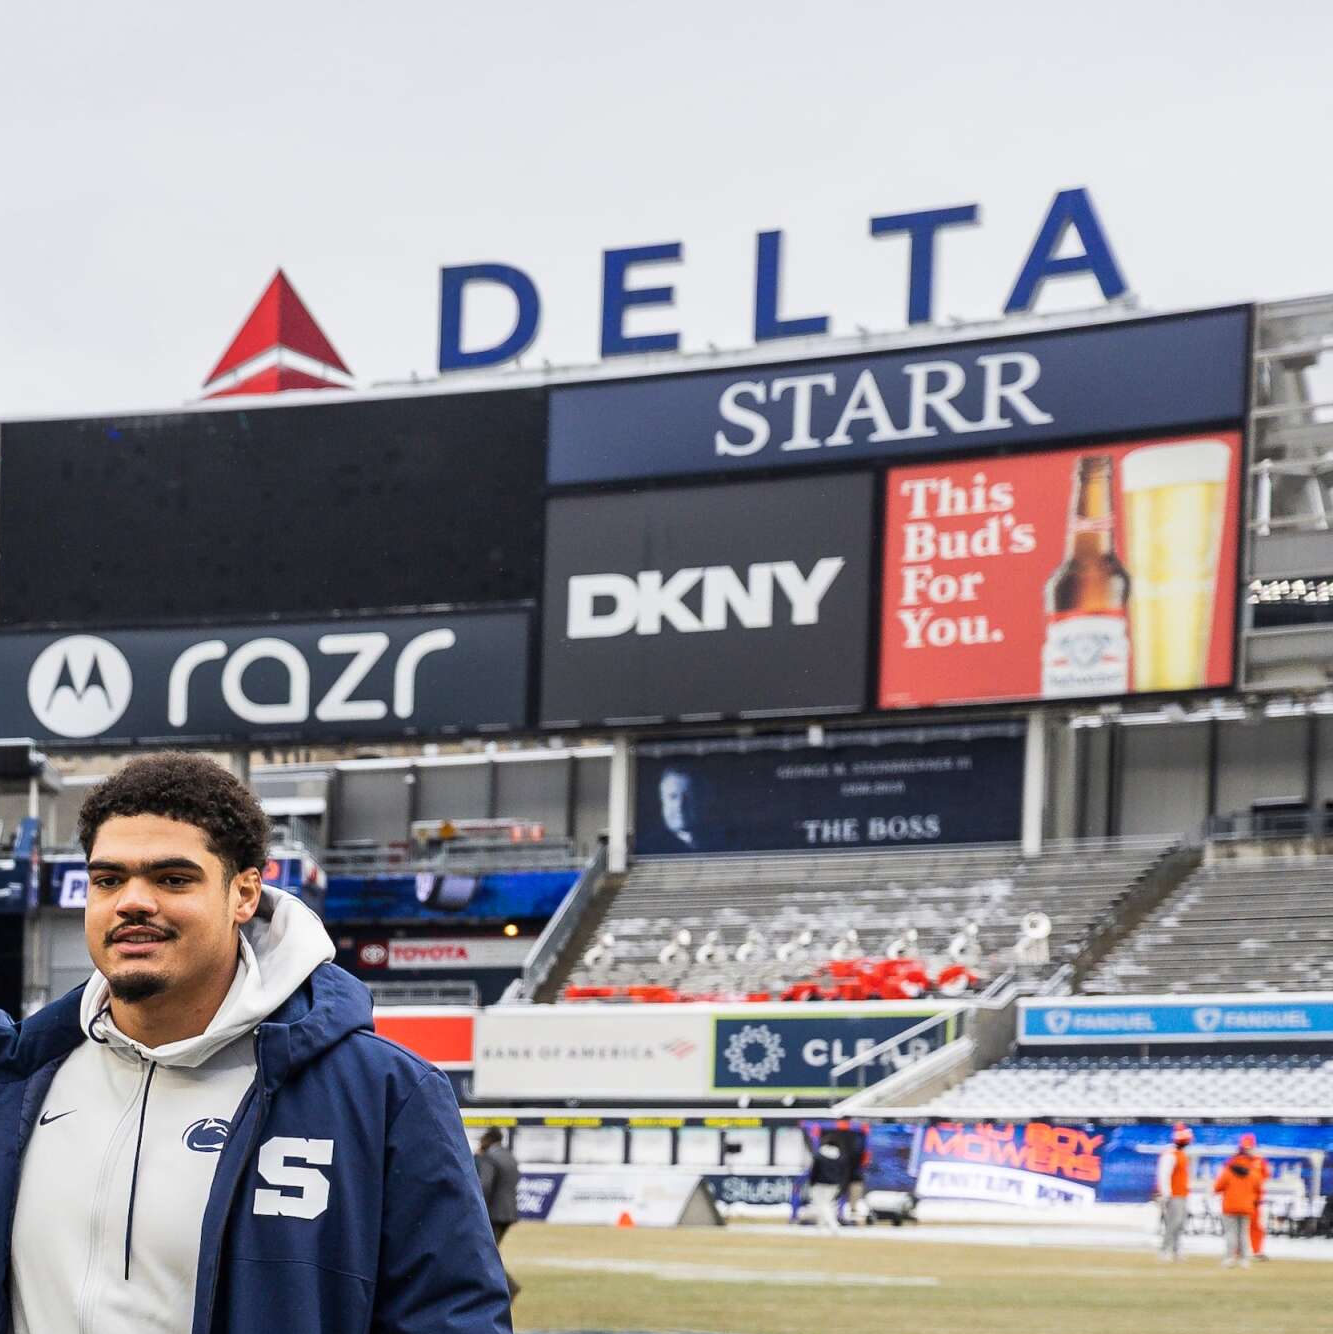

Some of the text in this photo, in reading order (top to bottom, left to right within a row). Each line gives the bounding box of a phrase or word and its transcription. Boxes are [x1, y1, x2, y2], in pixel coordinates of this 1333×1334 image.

[438, 187, 1129, 372] DELTA
[715, 352, 1053, 458] STARR
[900, 472, 1015, 522] This
[901, 514, 1036, 565] Bud's
[567, 557, 845, 640] DKNY
[901, 567, 985, 606] For
[898, 609, 1004, 649] You.
[168, 628, 456, 727] razr
[803, 814, 942, 844] THE BOSS
[392, 944, 469, 961] TOYOTA
[538, 1044, 561, 1060] OF
[568, 1044, 654, 1060] AMERICA
[253, 1136, 334, 1220] S
[923, 1126, 1102, 1183] MOWERS
